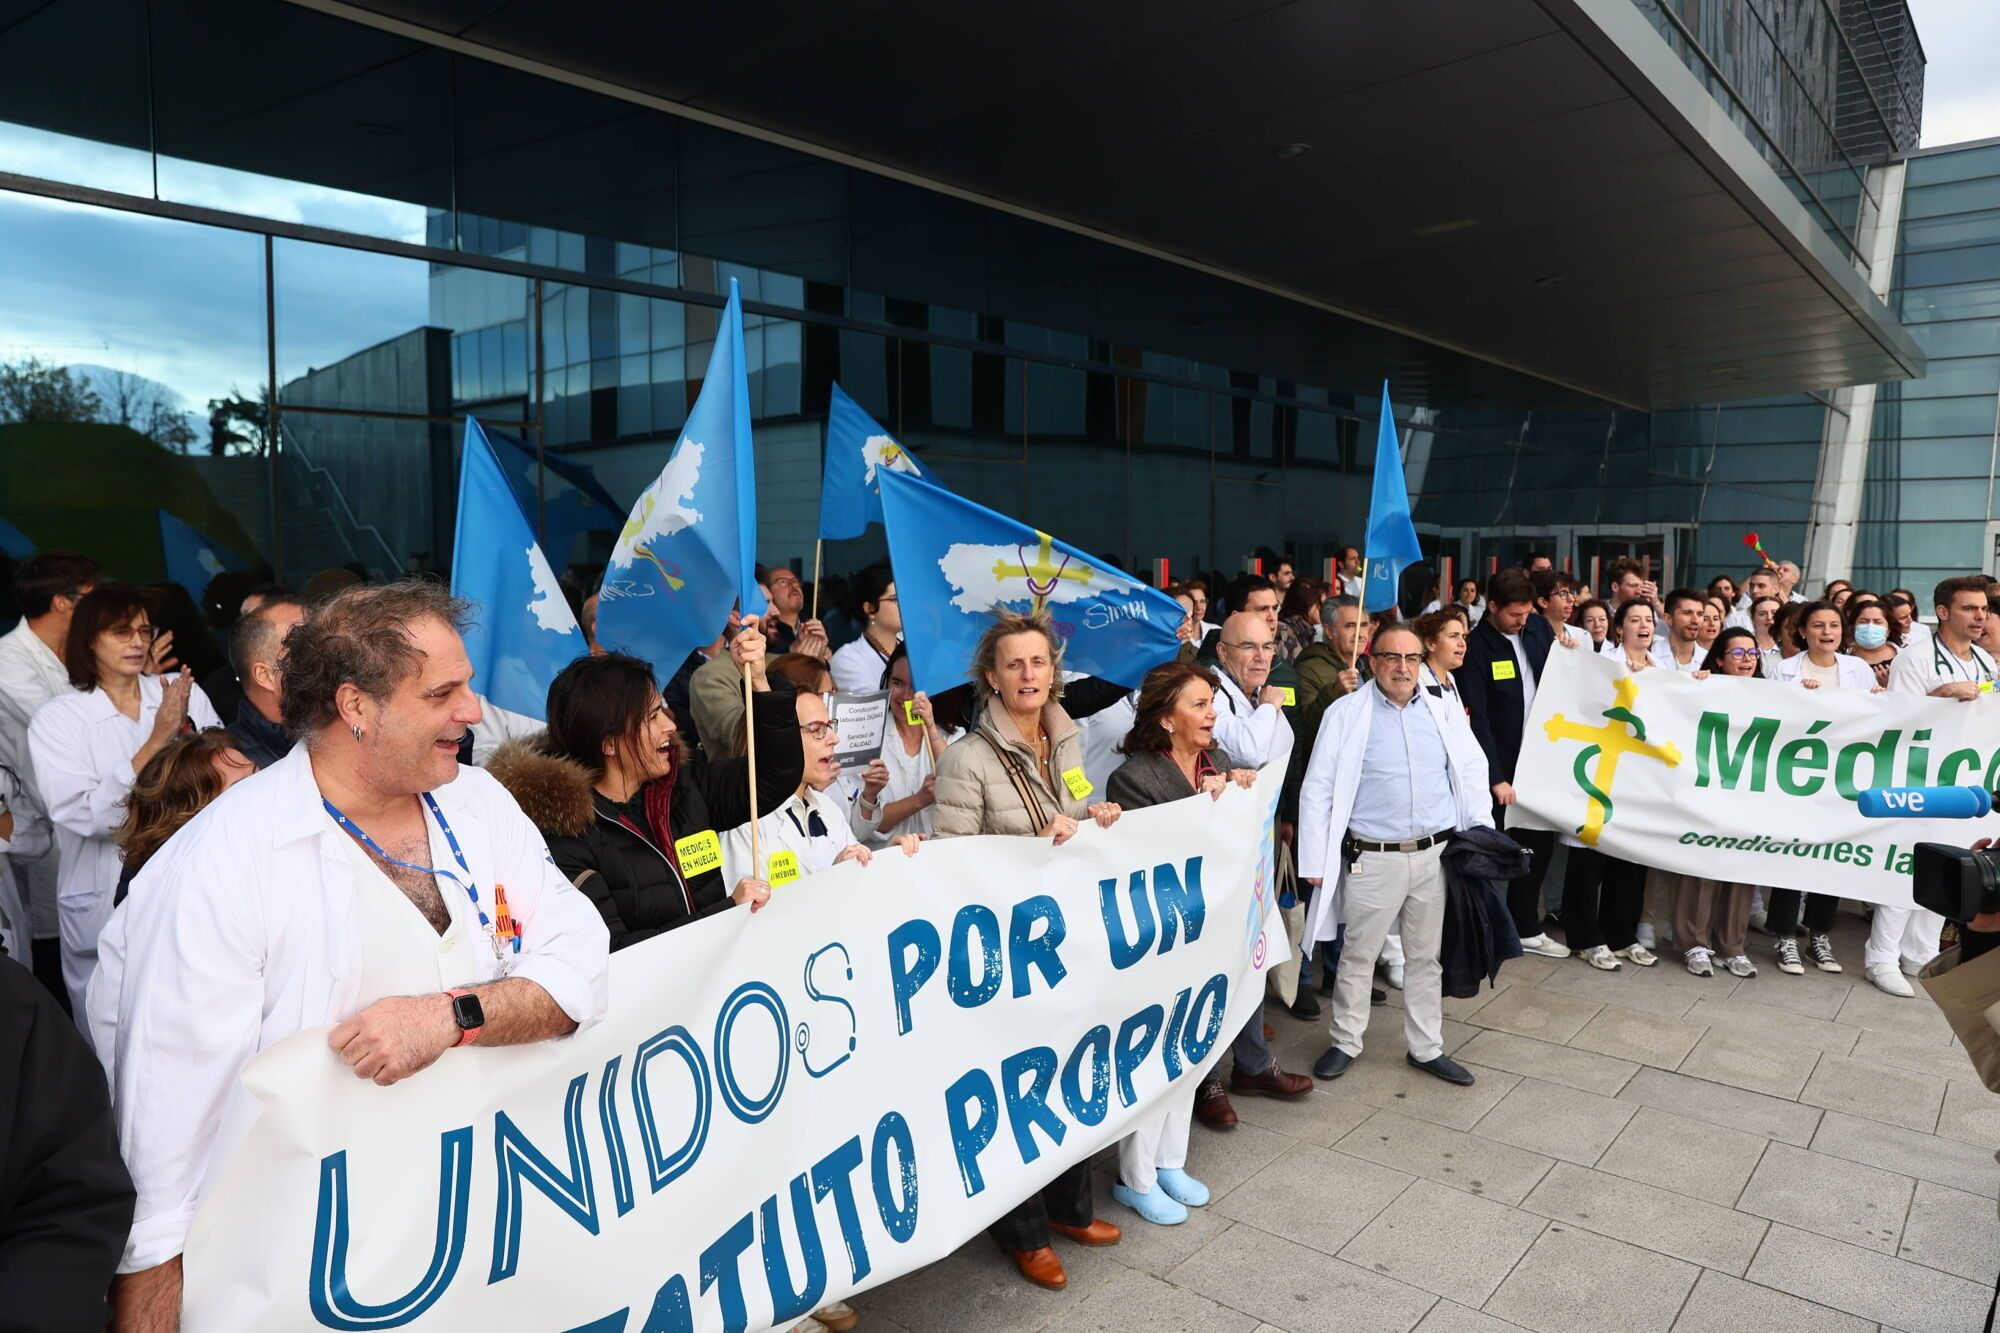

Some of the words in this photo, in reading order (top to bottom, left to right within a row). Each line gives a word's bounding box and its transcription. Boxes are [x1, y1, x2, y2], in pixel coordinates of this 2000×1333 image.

[1881, 790, 1926, 813] tve
[681, 861, 693, 872] EN
[693, 852, 718, 868] HUELGA
[1678, 830, 1874, 867] condiciones
[308, 941, 856, 1332] UNIDOS
[887, 894, 1068, 1037] POR
[1098, 855, 1206, 970] UN
[944, 973, 1229, 1198] PROPIO
